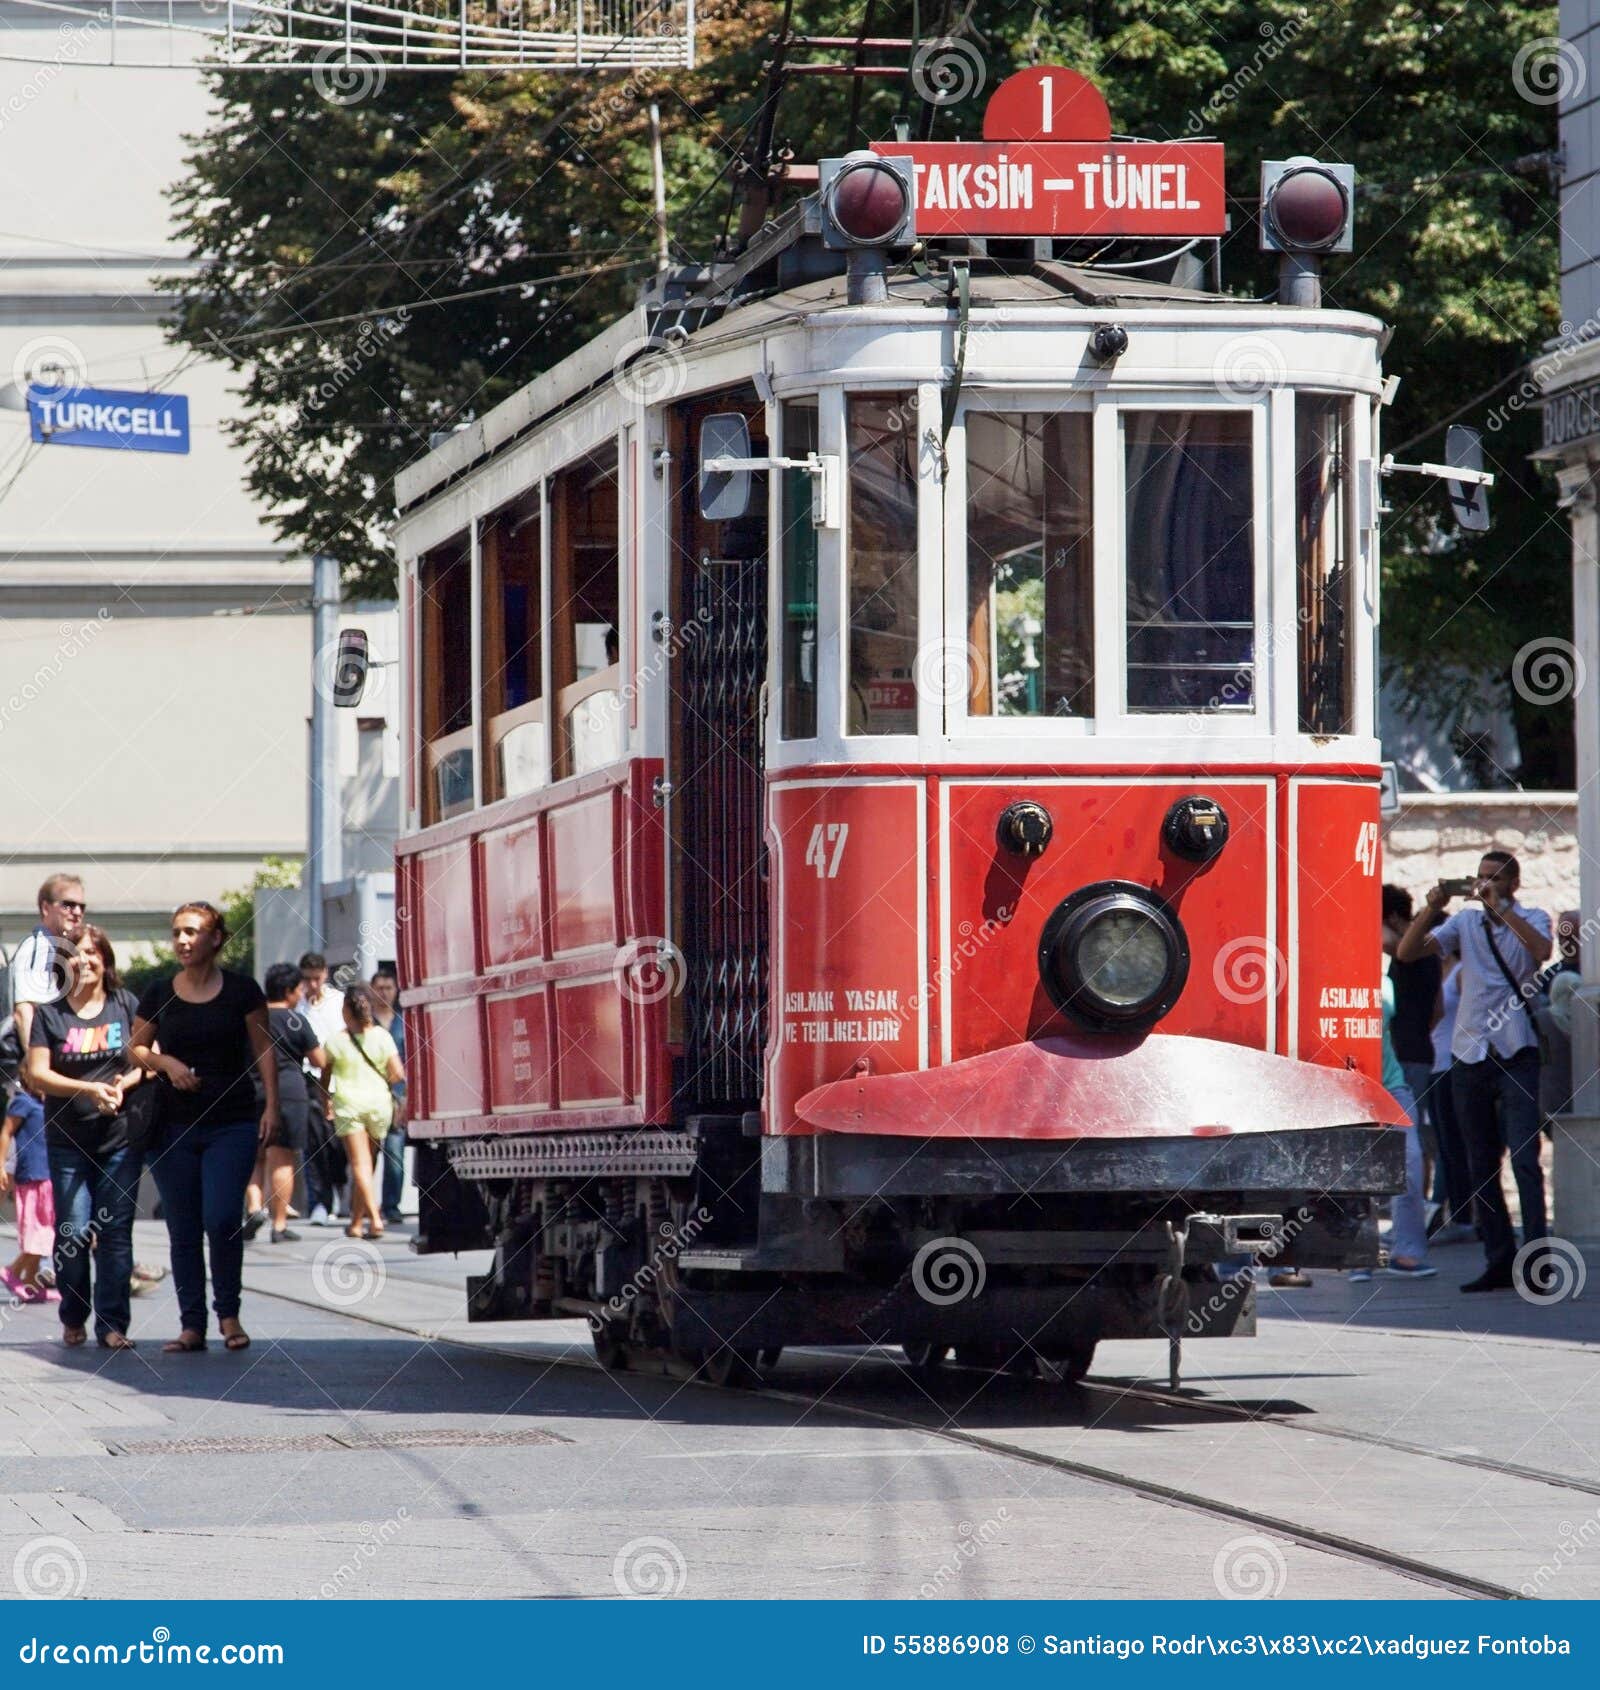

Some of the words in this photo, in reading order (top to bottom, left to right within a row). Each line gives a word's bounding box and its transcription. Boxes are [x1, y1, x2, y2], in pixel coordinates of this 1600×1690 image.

[1038, 76, 1053, 133] 1
[1077, 155, 1200, 210] TÜNEL
[38, 400, 182, 437] TURKCELL
[806, 823, 849, 878] 47
[1355, 821, 1378, 876] 47
[845, 990, 898, 1012] YASAK
[62, 1022, 123, 1053] NIKE
[1319, 1017, 1339, 1039] VE
